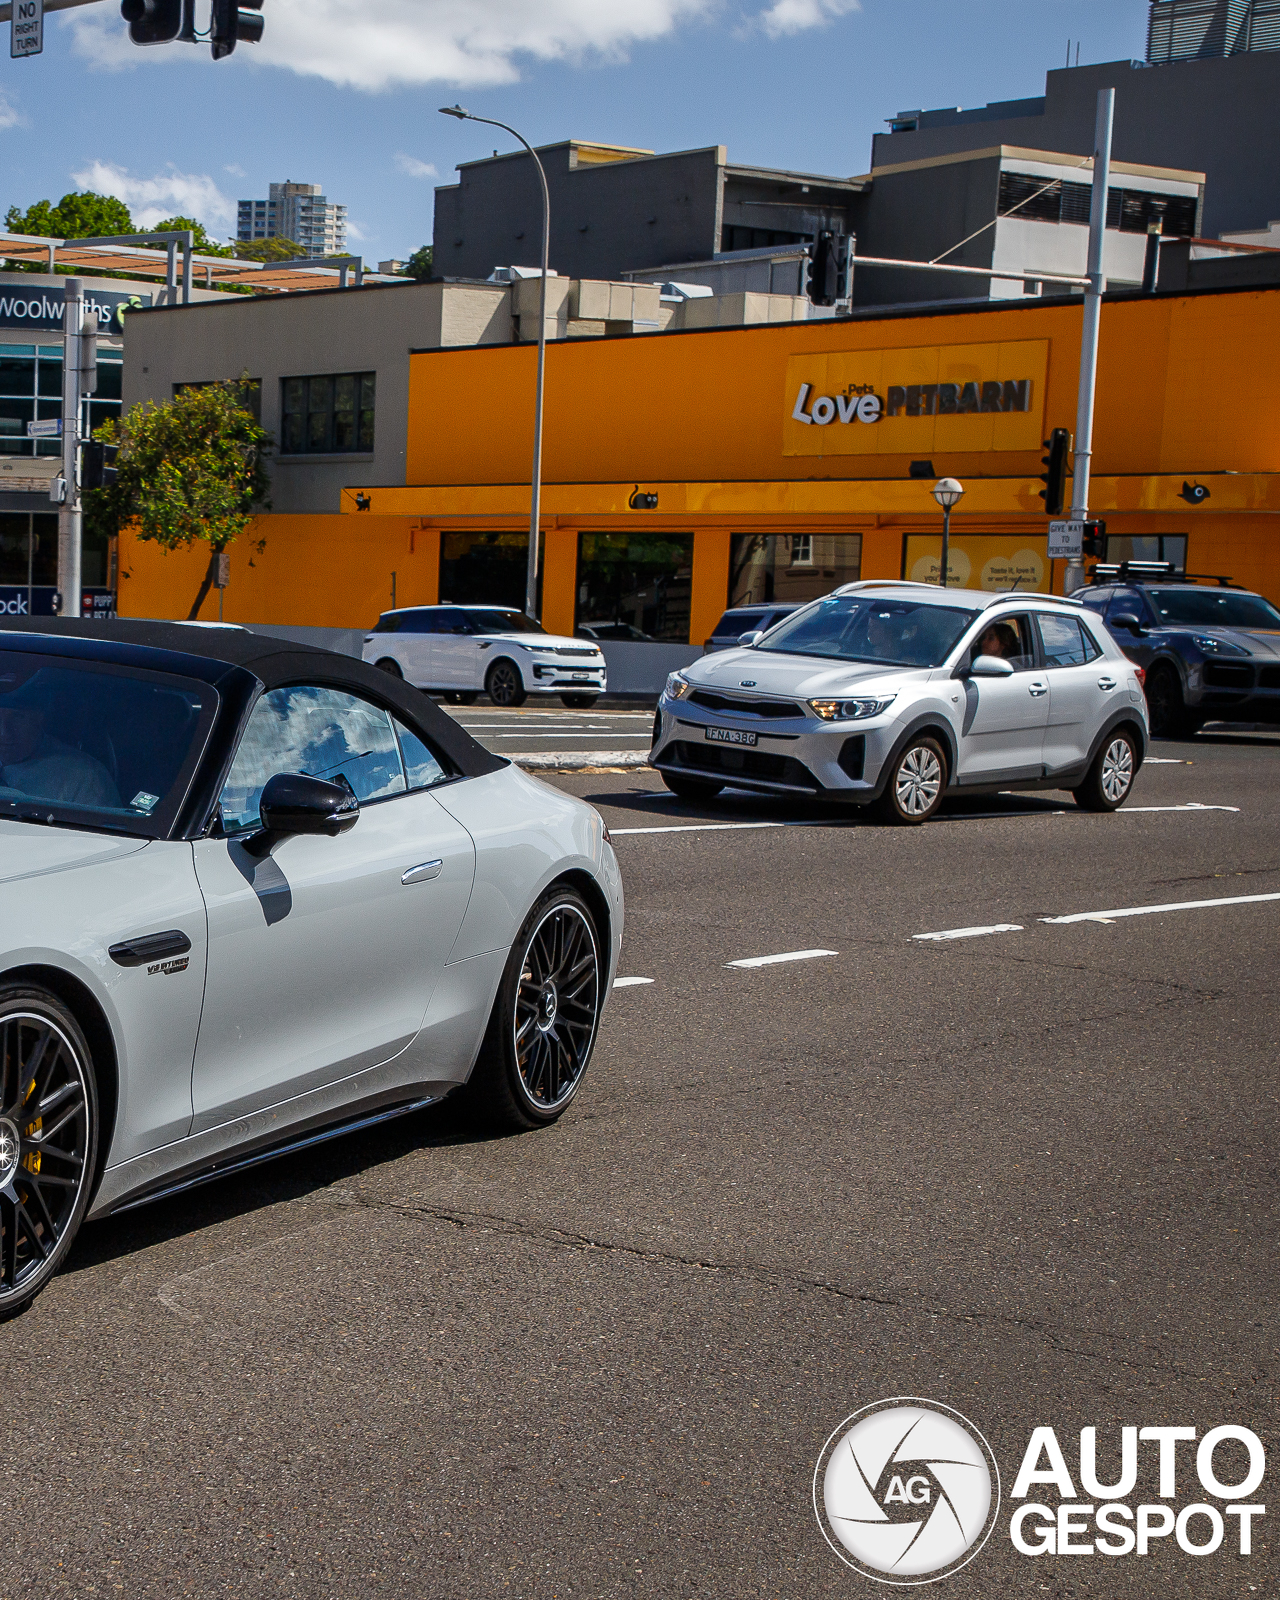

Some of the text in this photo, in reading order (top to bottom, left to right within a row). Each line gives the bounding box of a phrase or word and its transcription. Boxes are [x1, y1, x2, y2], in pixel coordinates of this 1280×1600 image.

[18, 1, 37, 19] NO
[15, 20, 39, 35] RIGHT
[16, 36, 38, 50] TURN
[848, 383, 874, 395] Pets
[792, 379, 1031, 426] Love PETBARN
[1050, 525, 1065, 533] GIVE
[1061, 535, 1070, 544] TO
